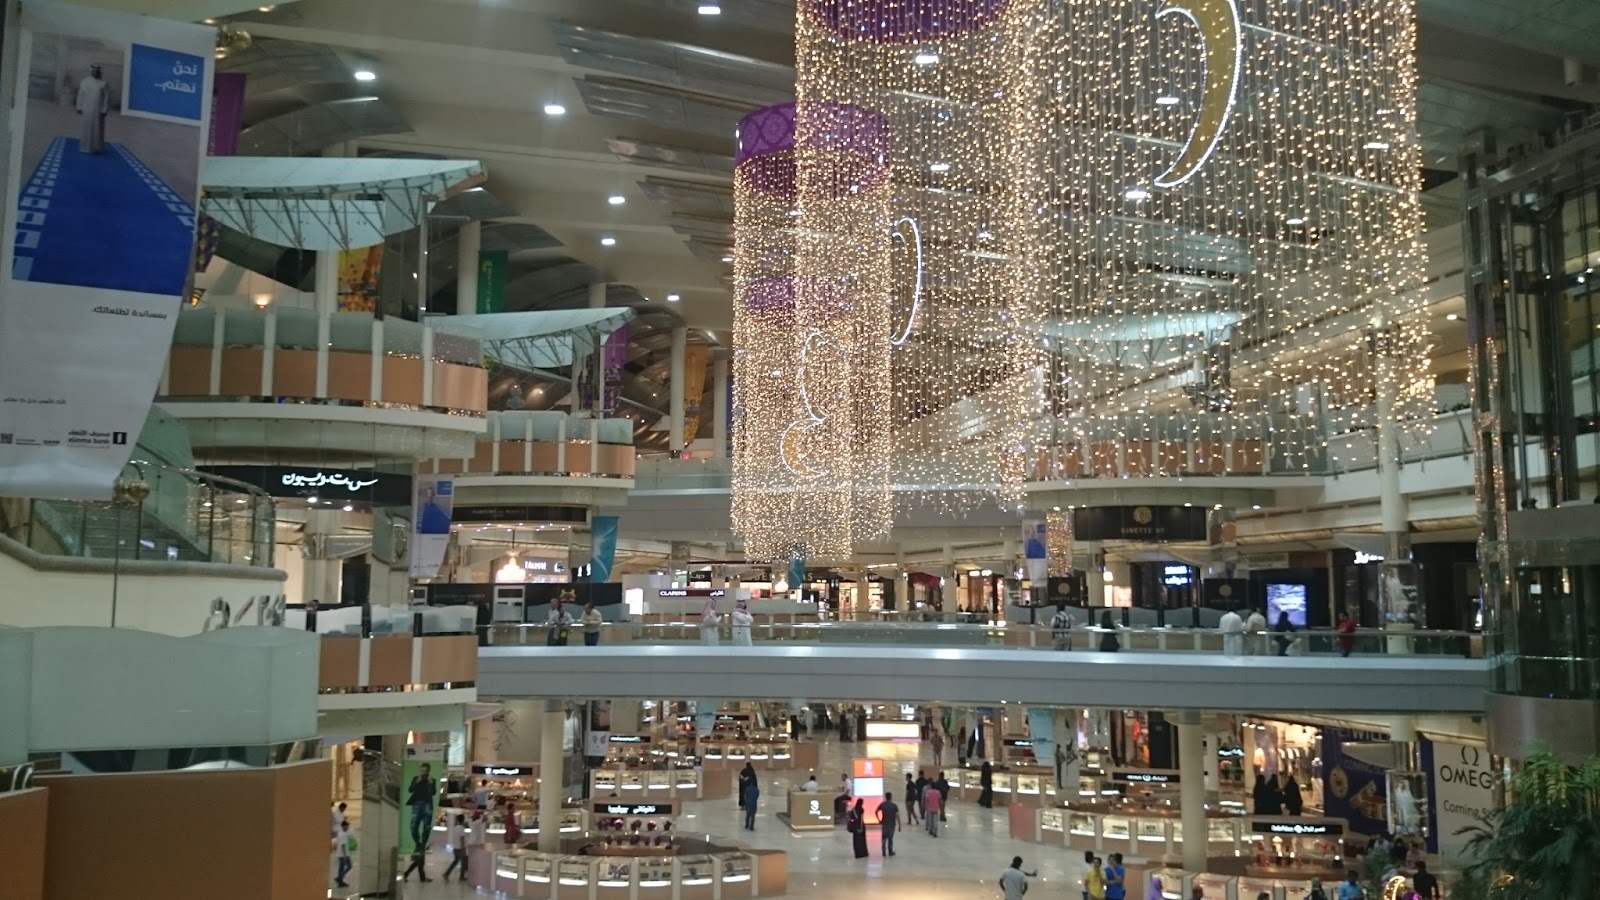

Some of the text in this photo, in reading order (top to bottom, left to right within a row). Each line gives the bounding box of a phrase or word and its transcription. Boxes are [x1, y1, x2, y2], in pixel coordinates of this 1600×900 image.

[173, 60, 197, 75] نحن
[1440, 765, 1492, 789] OMEG
[1443, 800, 1480, 820] Coming
